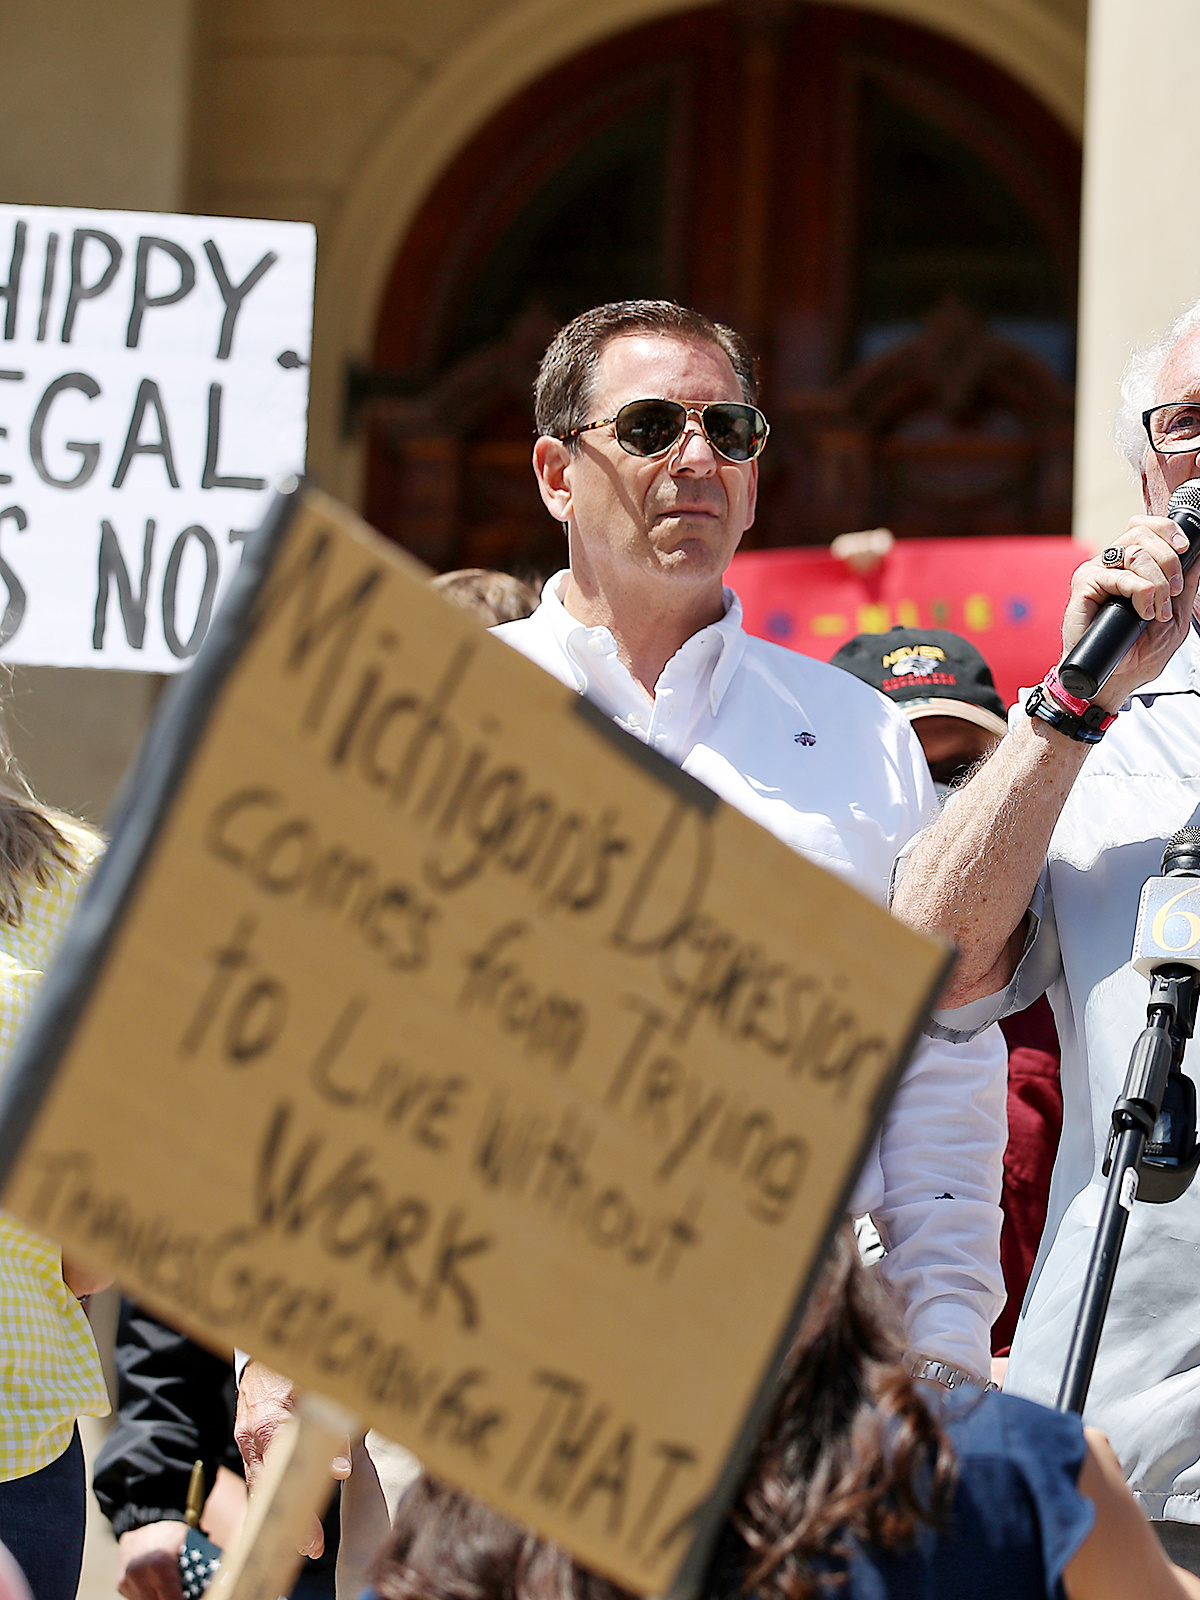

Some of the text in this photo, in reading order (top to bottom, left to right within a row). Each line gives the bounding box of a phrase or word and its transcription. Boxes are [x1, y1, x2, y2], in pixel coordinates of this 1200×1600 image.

[882, 645, 947, 669] NEVER
[178, 914, 289, 1066] to
[206, 786, 440, 972] comes
[456, 920, 588, 1075] from
[255, 1099, 496, 1335] WORK
